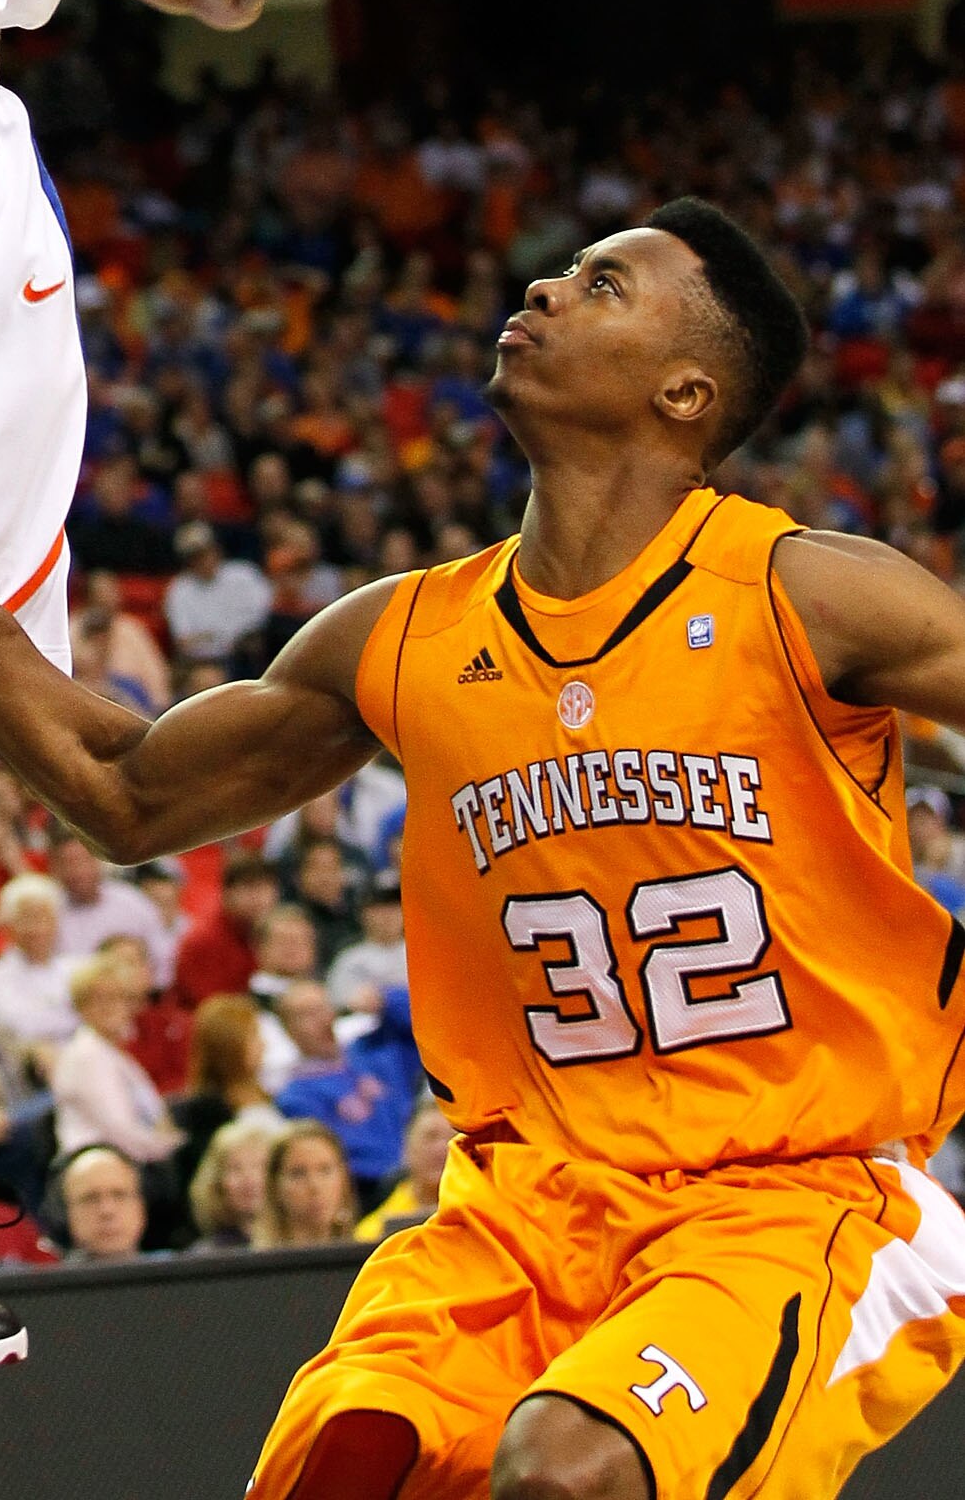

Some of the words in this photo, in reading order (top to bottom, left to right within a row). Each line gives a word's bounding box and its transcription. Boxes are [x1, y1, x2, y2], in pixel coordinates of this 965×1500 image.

[457, 669, 503, 685] adidas
[450, 747, 773, 875] TENNESSEE
[500, 865, 793, 1067] 32
[627, 1343, 708, 1418] T
